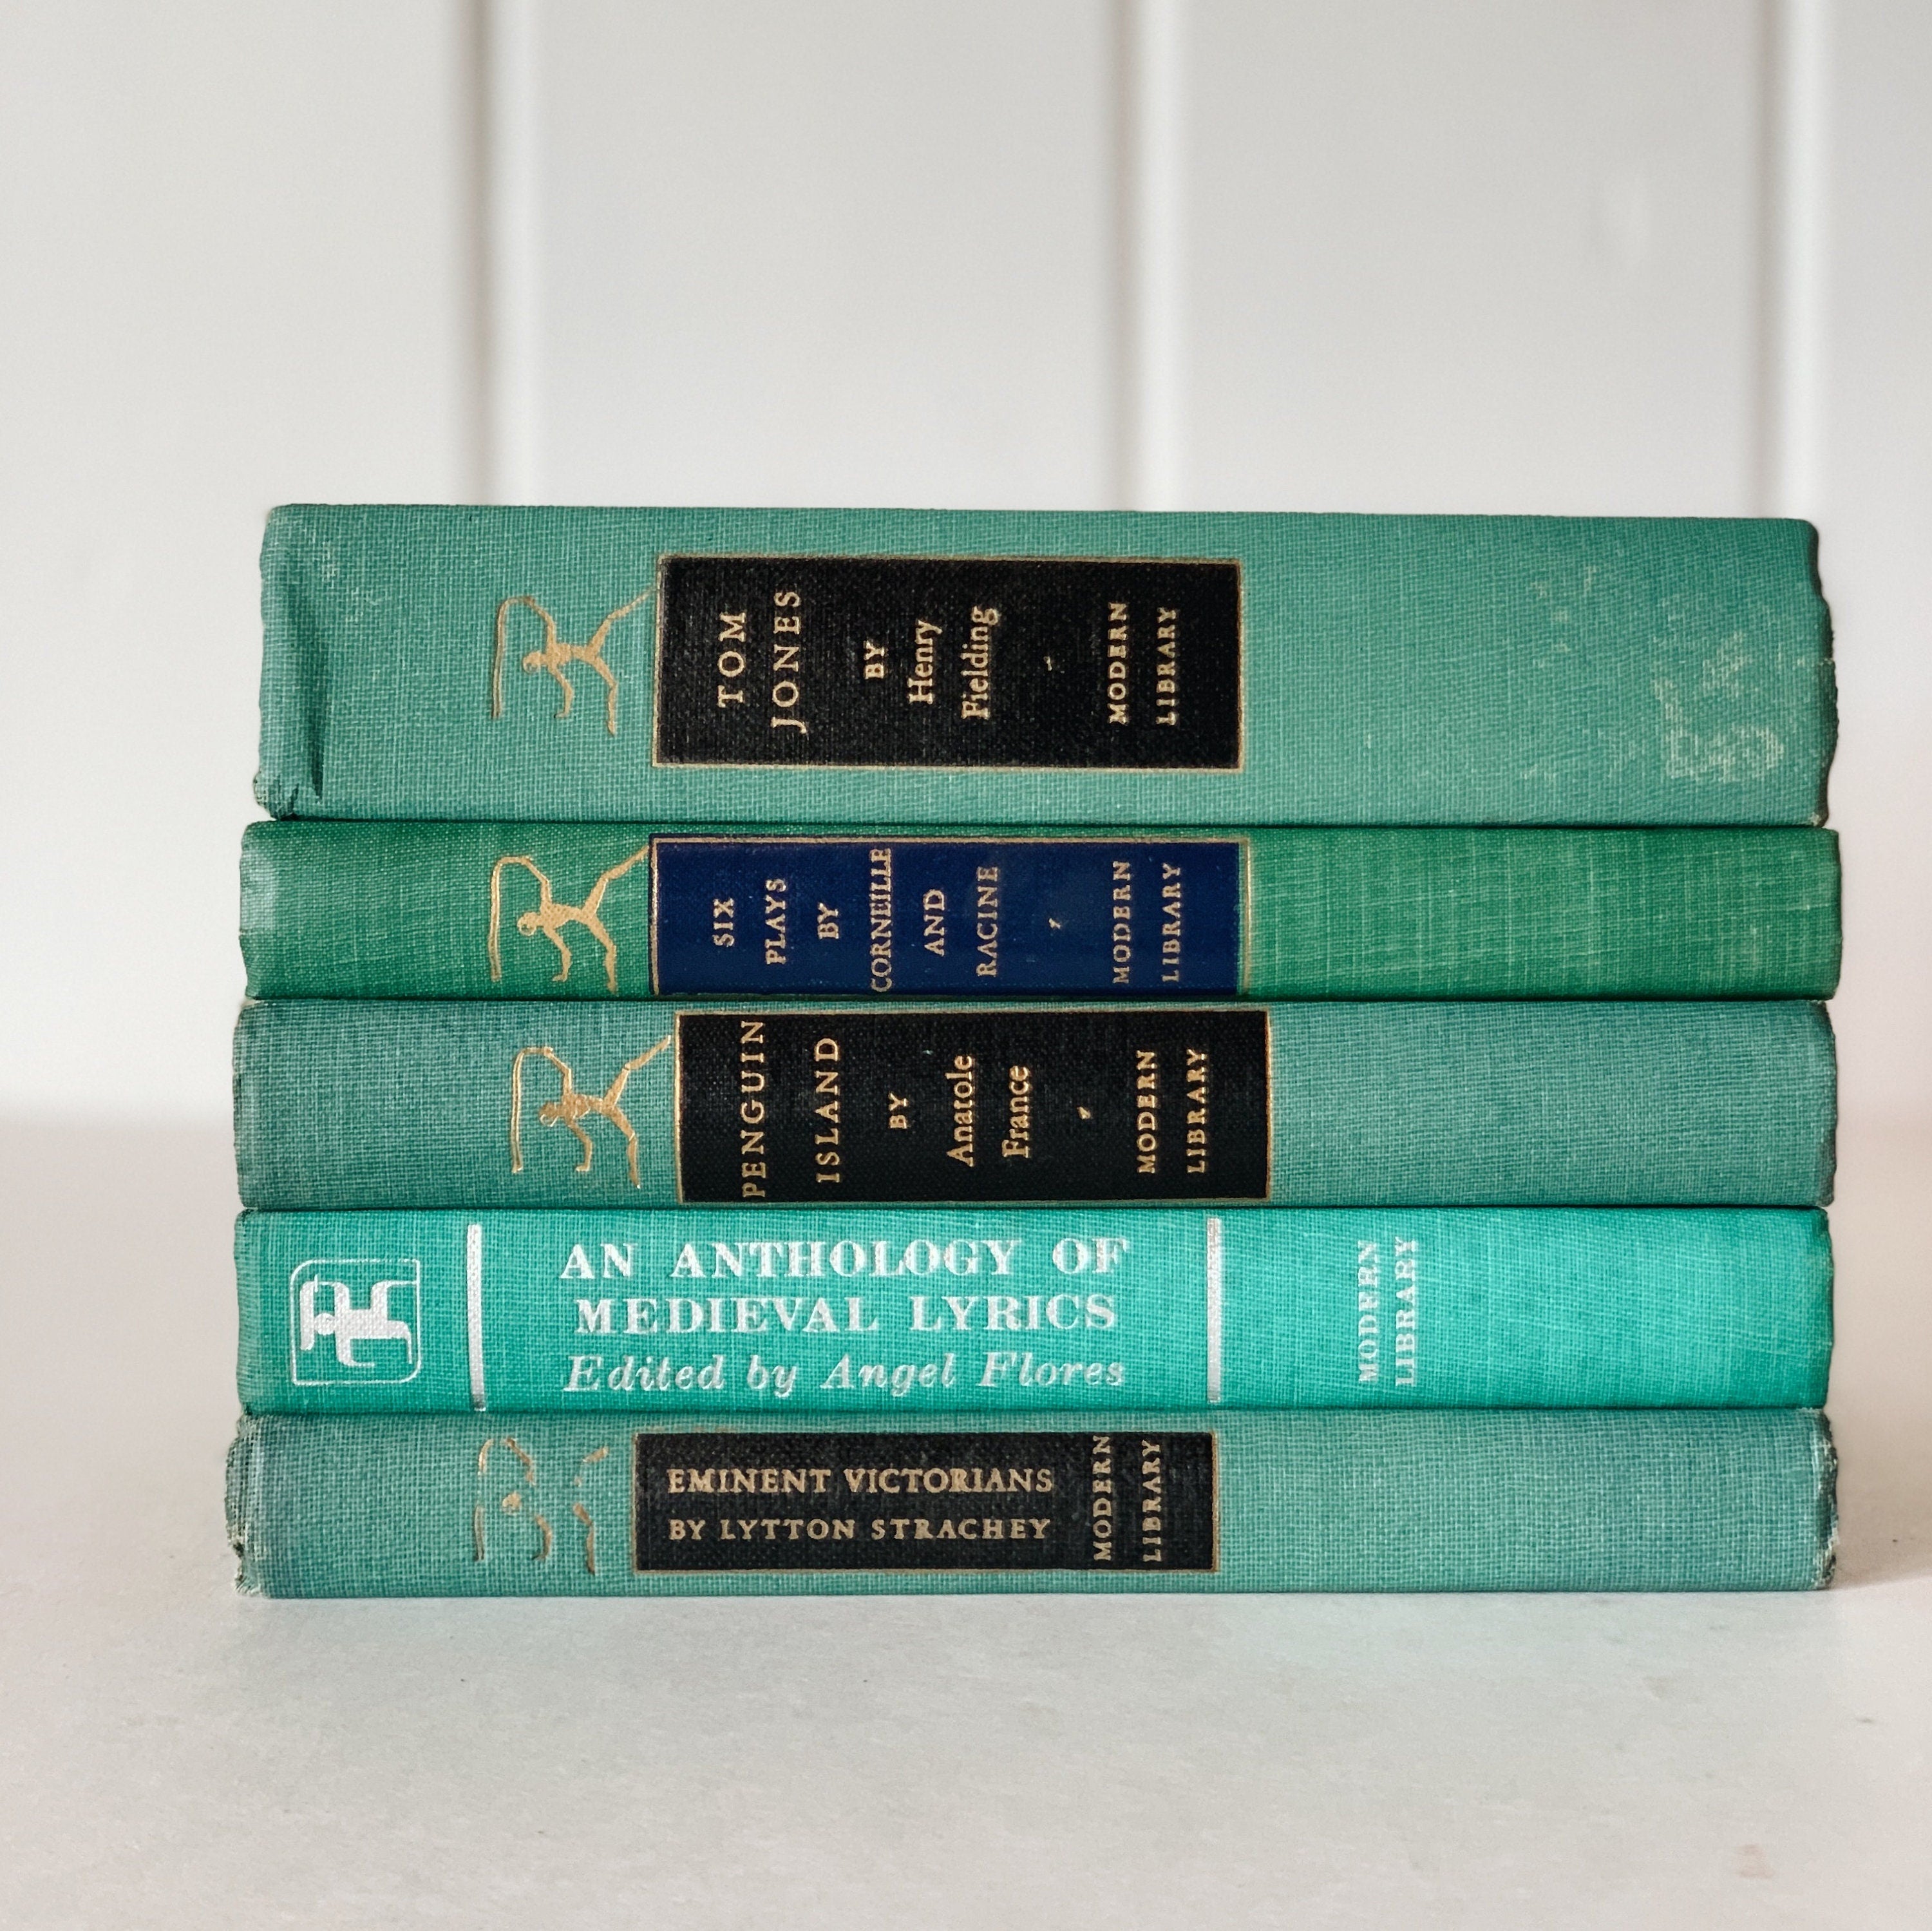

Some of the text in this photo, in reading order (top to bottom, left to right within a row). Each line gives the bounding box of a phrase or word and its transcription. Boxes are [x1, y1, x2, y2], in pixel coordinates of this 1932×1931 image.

[717, 611, 745, 707] TOM
[772, 591, 807, 734] JONES
[864, 640, 886, 680] BY
[907, 619, 940, 704] Henry
[960, 605, 999, 720] Fielding
[1107, 602, 1126, 724] MODERN
[1156, 607, 1175, 725] LIBRARY
[712, 897, 732, 947] SIX
[766, 878, 785, 965] PLAYS
[817, 903, 835, 940] BY
[870, 847, 891, 994] CORNEILLE
[923, 888, 943, 956] AND
[976, 866, 997, 977] RACINE
[1112, 861, 1128, 984] MODERN
[1162, 863, 1179, 983] LIBRARY
[741, 1020, 764, 1198] PENGUIN
[815, 1038, 838, 1184] ISLAND
[889, 1092, 905, 1130] BY
[945, 1054, 973, 1167] Anatole
[1001, 1065, 1028, 1159] France
[1137, 1050, 1155, 1174] MODERN
[1186, 1049, 1206, 1174] LIBRARY
[560, 1237, 1129, 1279] AN ANTHOLOGY OF
[577, 1293, 1116, 1334] MEDIEVAL LYRICS
[1356, 1240, 1377, 1384] MODERN
[1394, 1235, 1415, 1387] LIBRARY
[564, 1351, 1126, 1397] Edited by Angel Flores
[668, 1468, 1052, 1492] EMINENT VICTORIANS
[670, 1518, 1050, 1539] BY LYTTON STRACHEY
[1092, 1436, 1111, 1561] MODERN
[1142, 1439, 1160, 1563] LIBRARY
